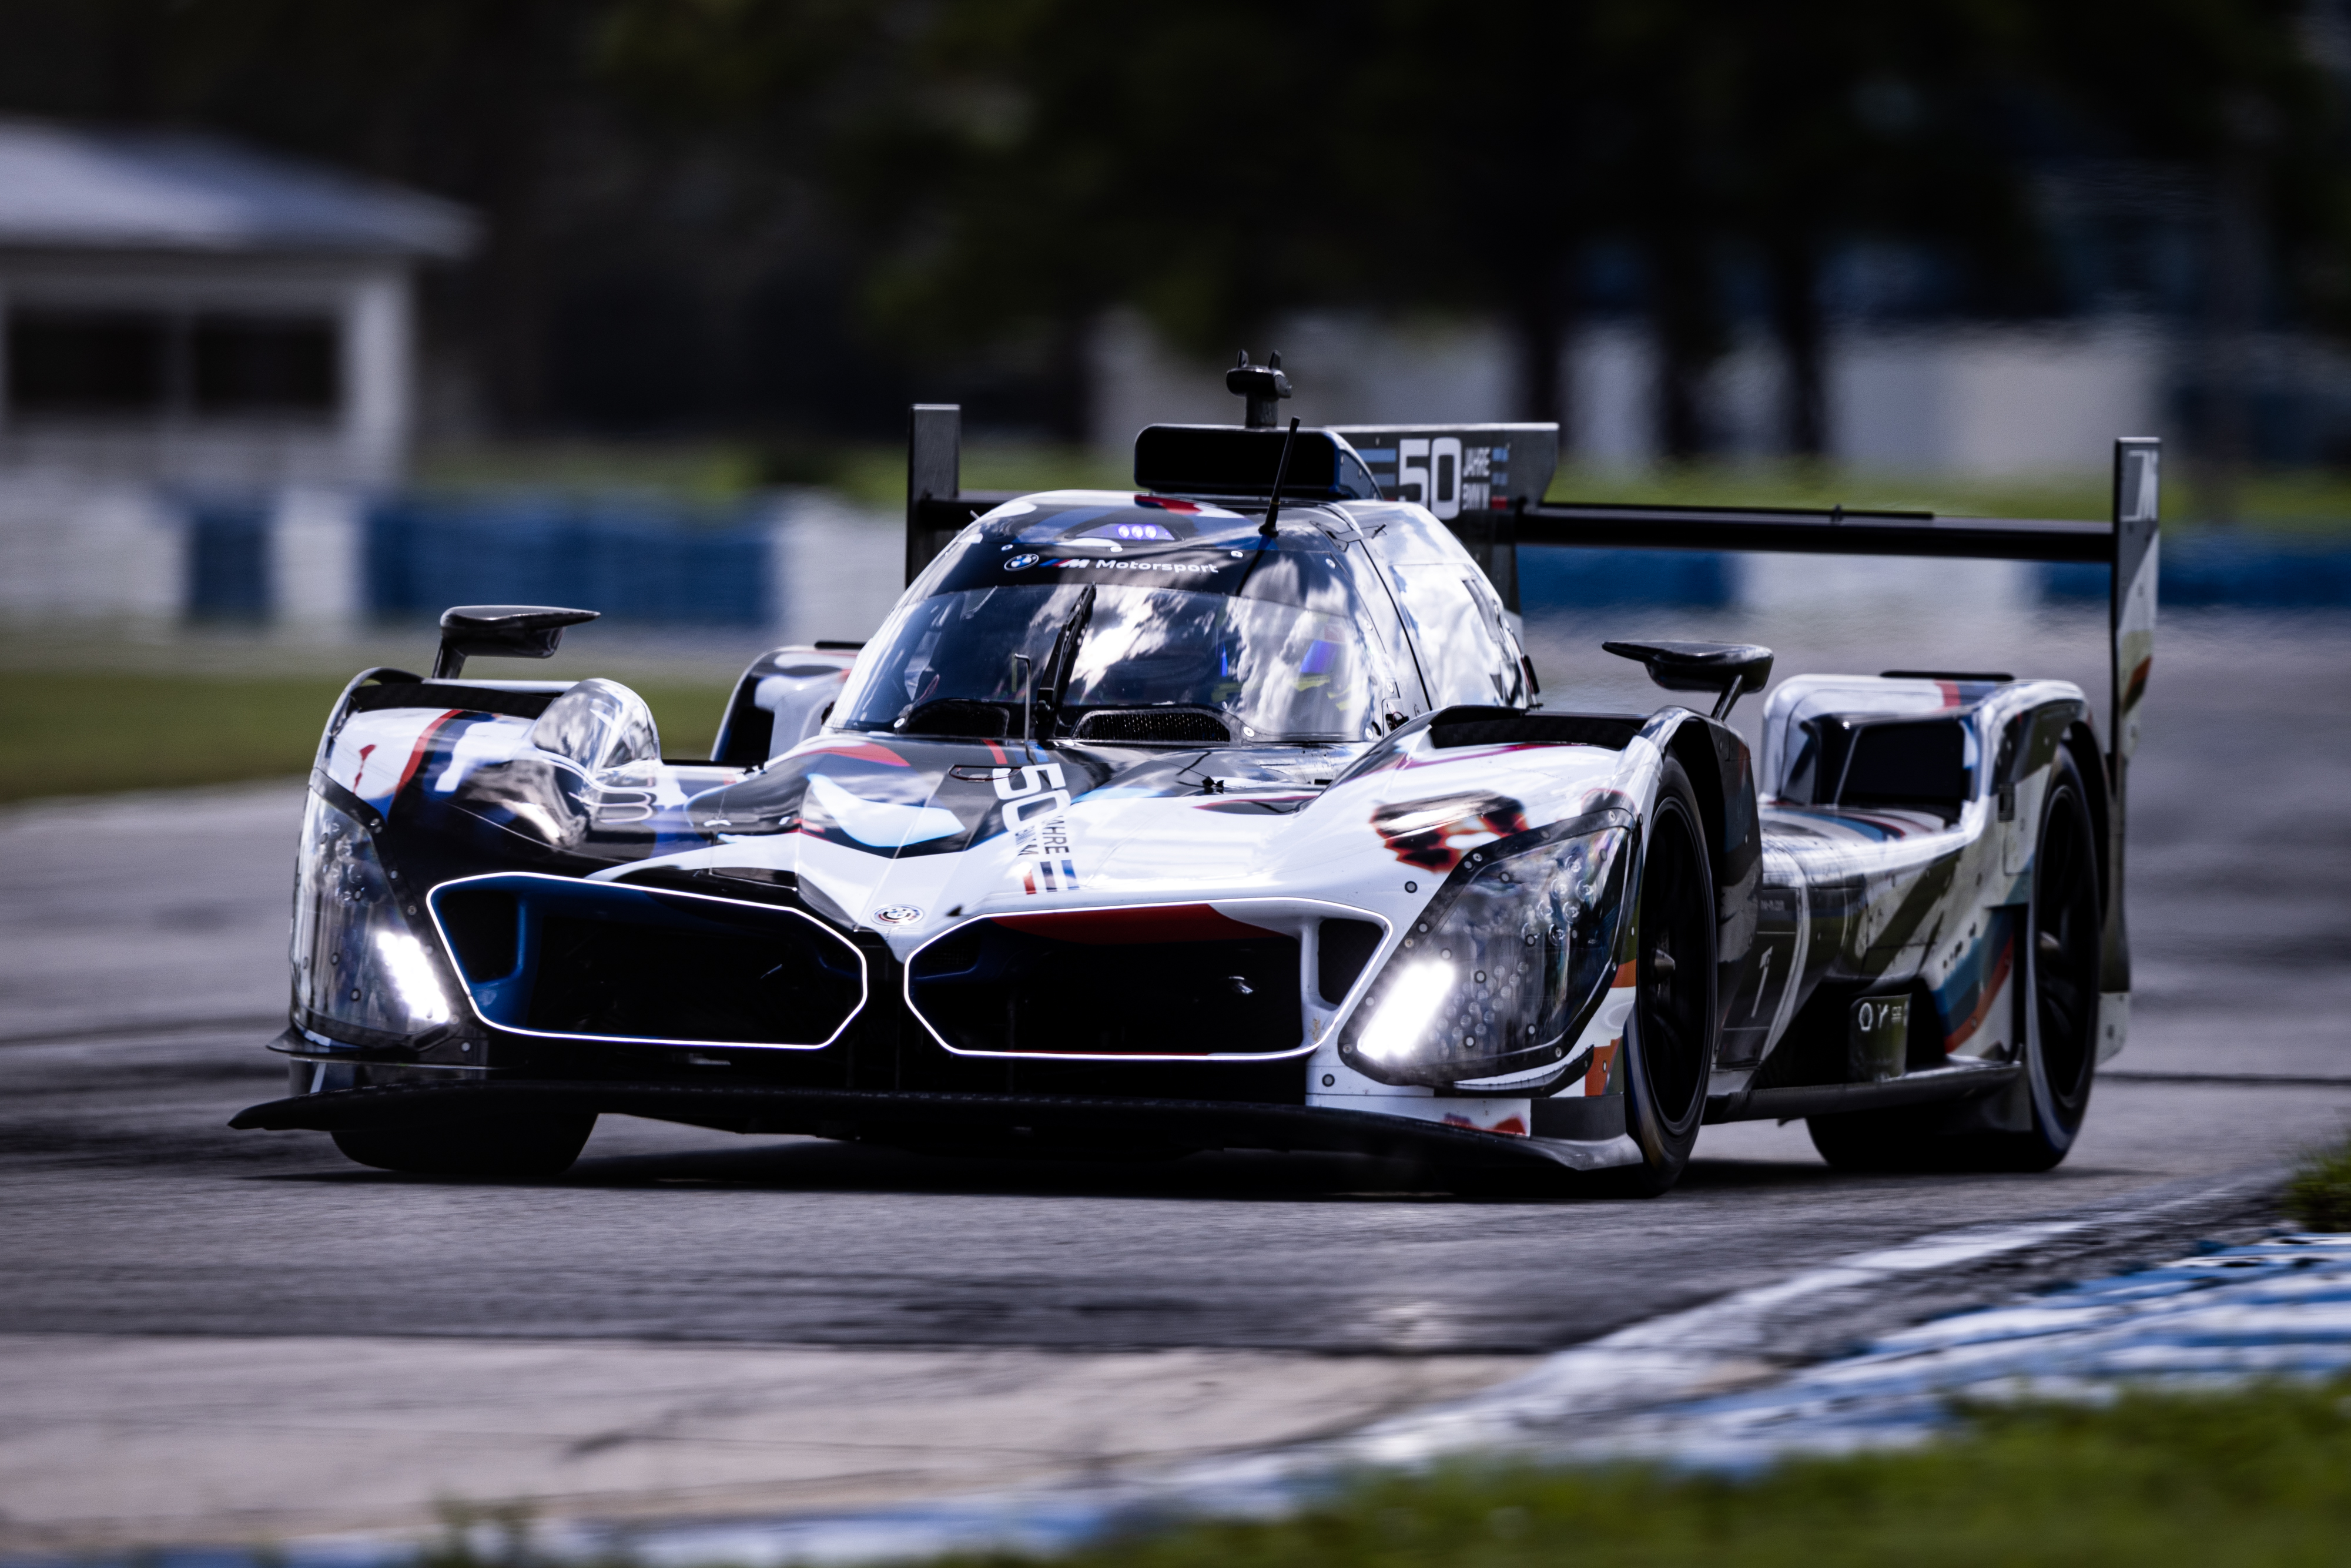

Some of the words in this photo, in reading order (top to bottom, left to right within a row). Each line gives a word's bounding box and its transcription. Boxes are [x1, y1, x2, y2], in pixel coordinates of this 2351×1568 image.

[1399, 437, 1462, 520] 50
[1096, 559, 1219, 573] Motorsport
[993, 763, 1071, 832] 50
